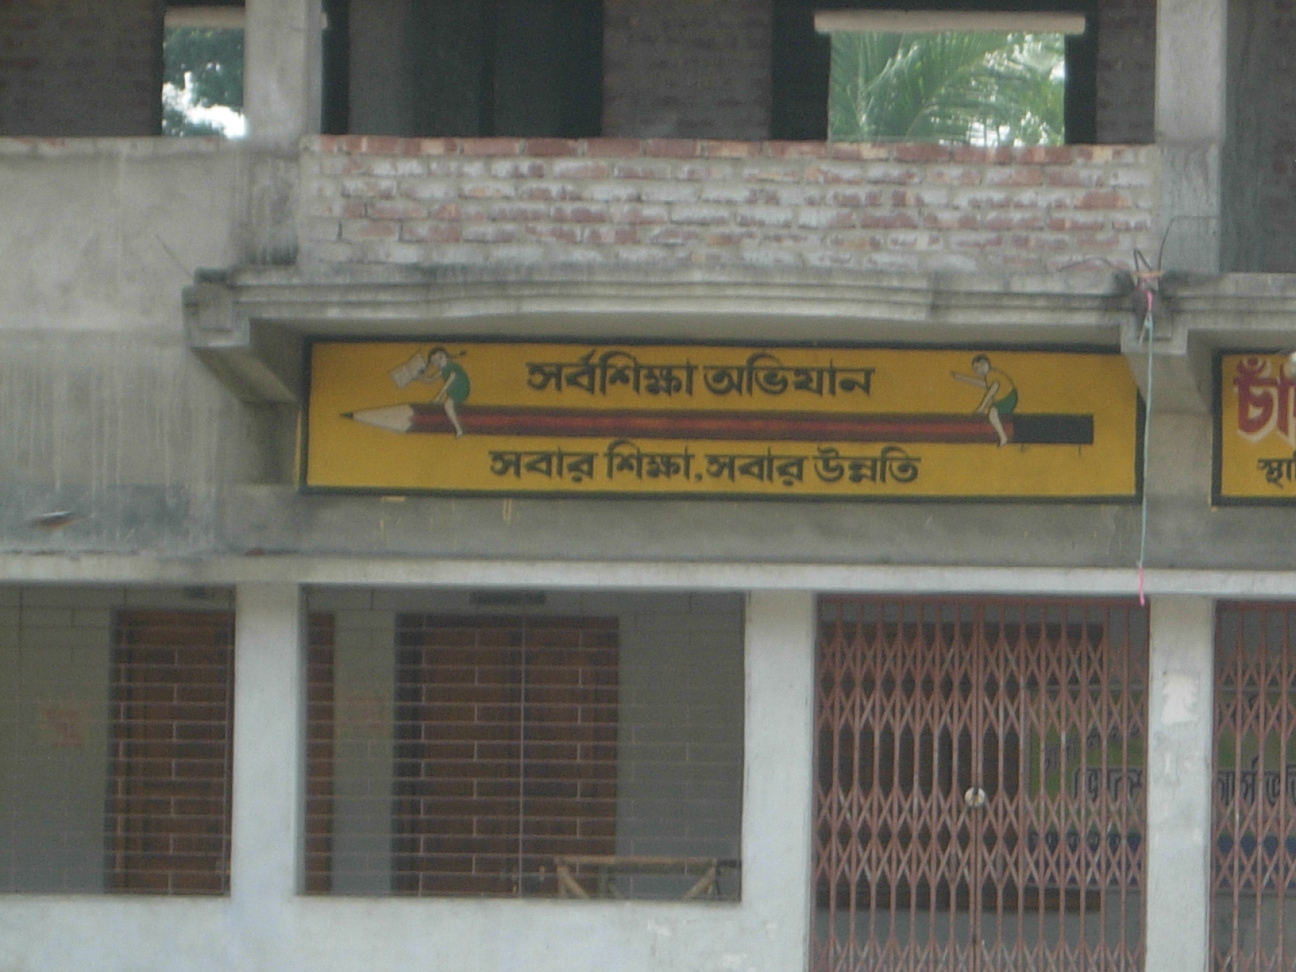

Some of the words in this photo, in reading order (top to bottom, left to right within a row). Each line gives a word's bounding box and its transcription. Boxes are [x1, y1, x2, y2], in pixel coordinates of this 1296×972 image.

[703, 352, 876, 397] অভিযান
[488, 446, 598, 482] সবার
[705, 445, 808, 487] সবার
[811, 445, 922, 484] উন্নতি
